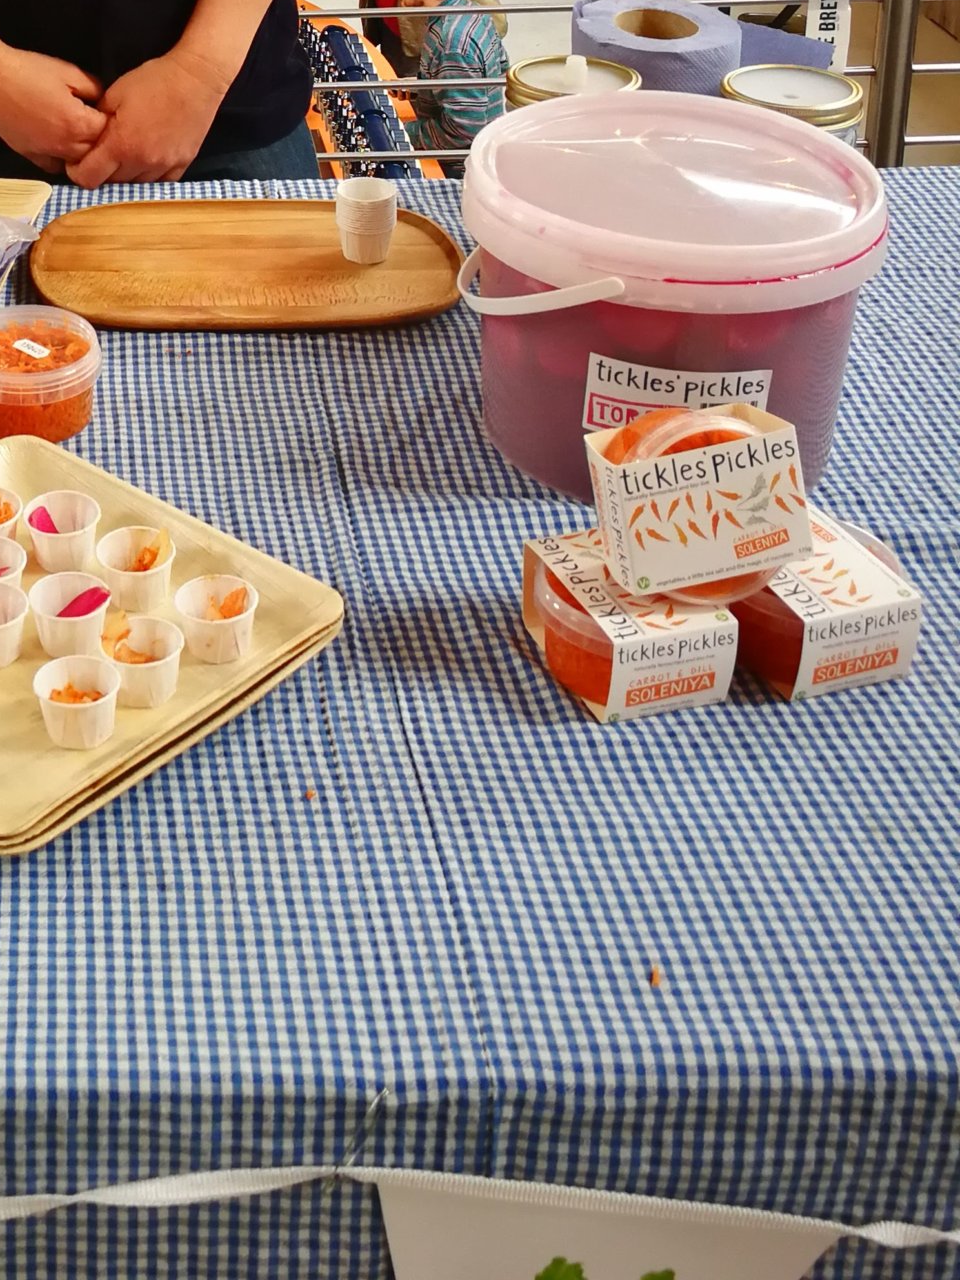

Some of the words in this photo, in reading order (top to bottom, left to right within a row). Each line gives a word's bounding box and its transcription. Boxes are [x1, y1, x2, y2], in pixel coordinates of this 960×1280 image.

[683, 376, 765, 403] pickles
[596, 401, 640, 425] TOR
[736, 531, 788, 557] SOLENIYA
[771, 570, 826, 619] tickle
[628, 672, 671, 688] CARROT
[690, 664, 713, 675] DILL
[815, 651, 894, 682] SOLENIYA
[628, 675, 711, 705] SOLENIYA
